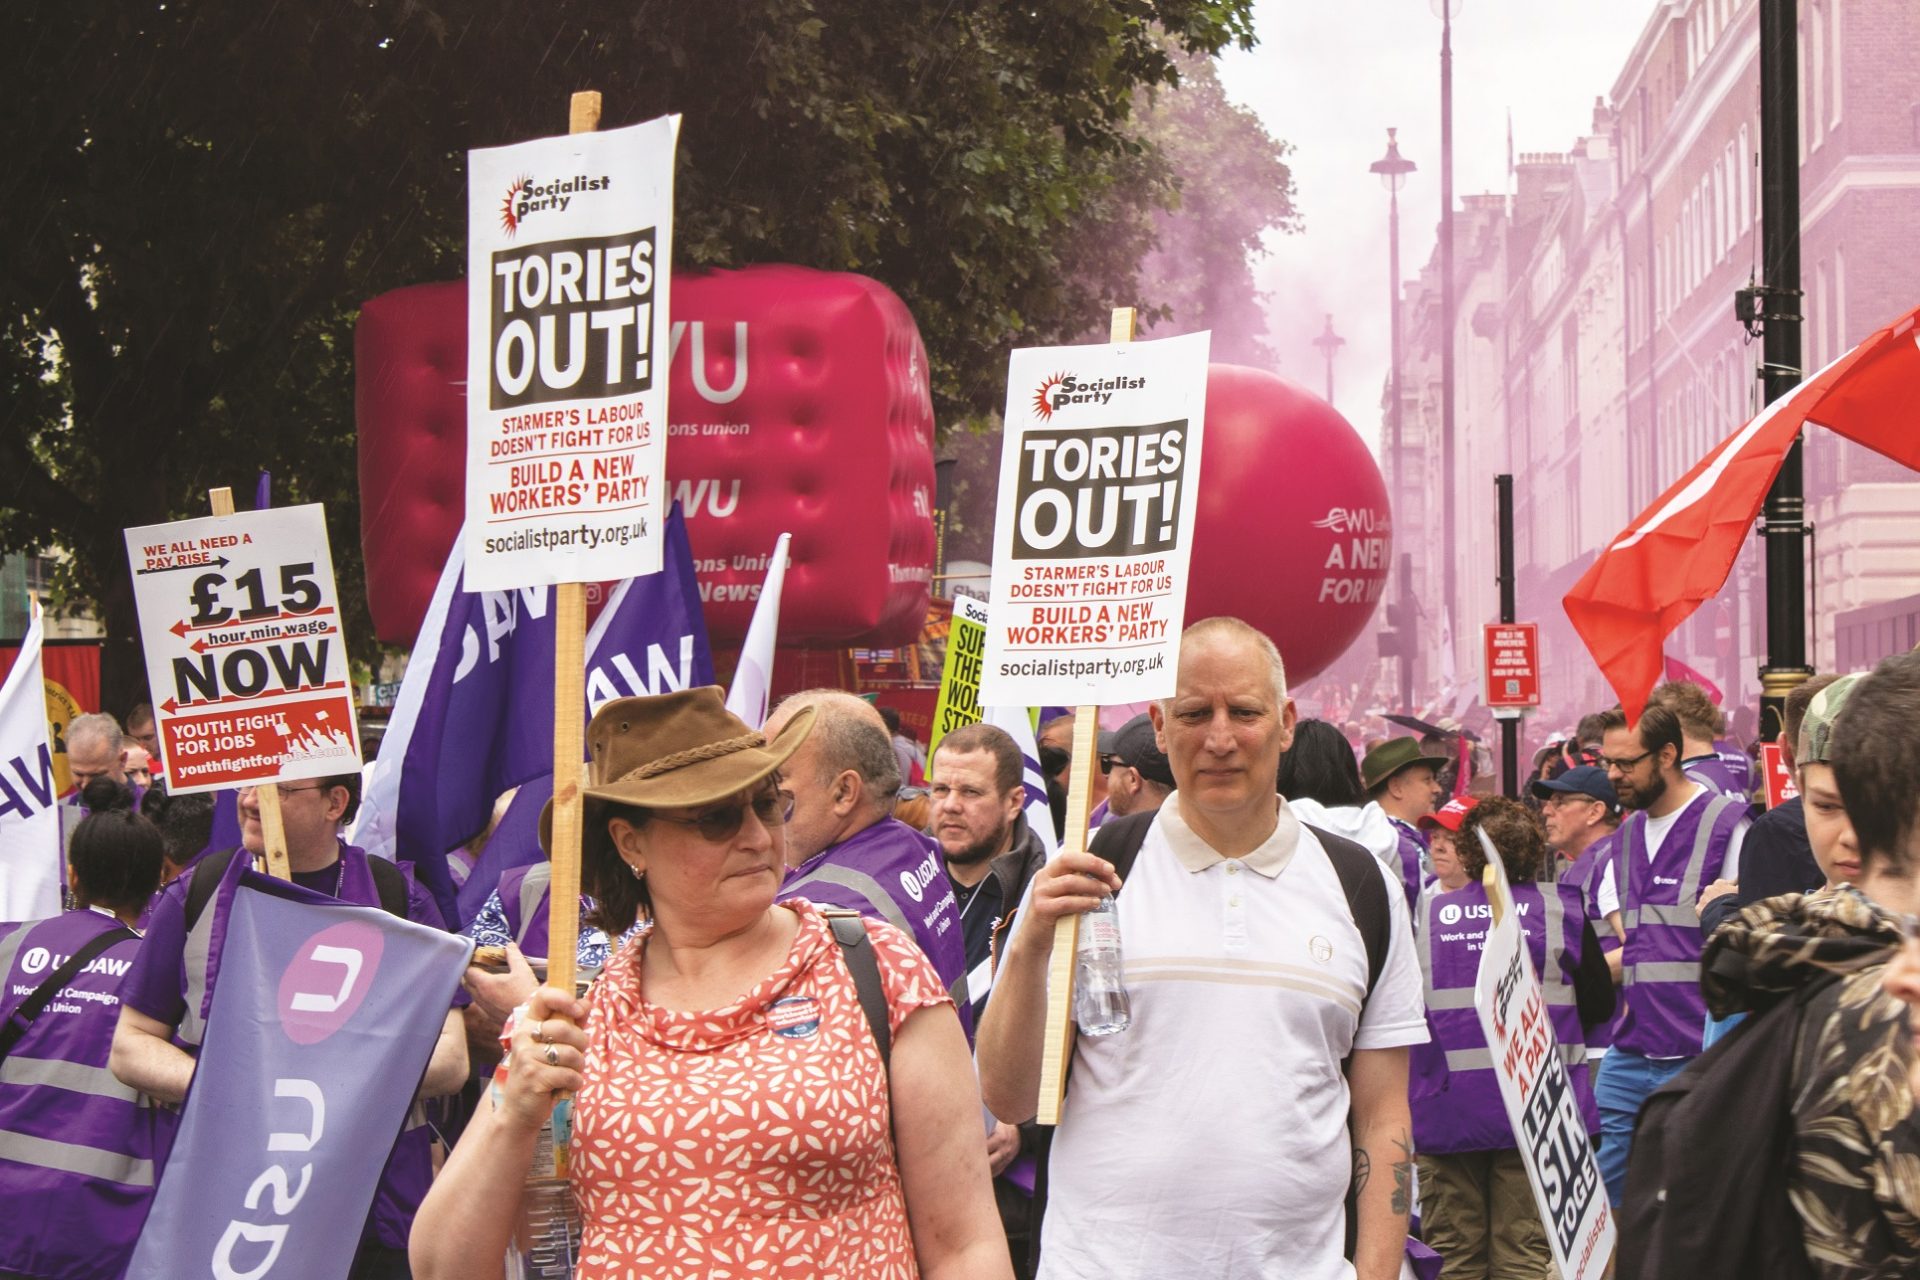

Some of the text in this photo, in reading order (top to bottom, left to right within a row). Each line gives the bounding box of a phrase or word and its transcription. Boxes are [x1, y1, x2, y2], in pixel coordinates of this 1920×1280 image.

[522, 175, 610, 201] Socialist
[495, 241, 653, 312] TORIES
[496, 303, 651, 396] OUT!
[1060, 376, 1146, 393] Socialist
[502, 402, 644, 434] STARMER'S LABOUR
[702, 421, 750, 436] union
[491, 422, 650, 457] DOESN'T FIGHT FOR US
[1025, 430, 1183, 482] TORIES
[511, 454, 635, 487] BUILD A NEW
[490, 475, 649, 514] WORKERS' PARTY
[1020, 480, 1178, 550] OUT!
[1328, 507, 1374, 533] CWU
[143, 533, 253, 557] WE ALL NEED A
[486, 517, 648, 554] socialistparty.org.uk
[146, 552, 211, 570] PAY RISE
[732, 553, 792, 572] Unin
[1324, 543, 1345, 569] A
[1024, 560, 1165, 580] STARMER'S LABOUR
[189, 562, 322, 628] £15
[1010, 576, 1172, 598] DOESN'T FIGHT FOR US
[1318, 578, 1365, 604] FOR
[1032, 602, 1153, 625] BUILD A NEW
[208, 620, 328, 645] hour min wage
[1007, 619, 1168, 645] WORKERS' PARTY
[172, 639, 330, 705] NOW
[587, 635, 694, 719] AW
[1000, 652, 1164, 679] socialistparty.org.uk
[172, 712, 286, 739] YOUTH FIGHT
[176, 734, 255, 755] FOR JOBS
[178, 745, 347, 779] youthfightforjobs.com
[1440, 932, 1465, 942] Work
[1467, 931, 1484, 939] and
[52, 1002, 82, 1014] Union
[65, 988, 119, 1006] Campaign
[1503, 1027, 1523, 1081] WE
[1519, 1072, 1530, 1104] A
